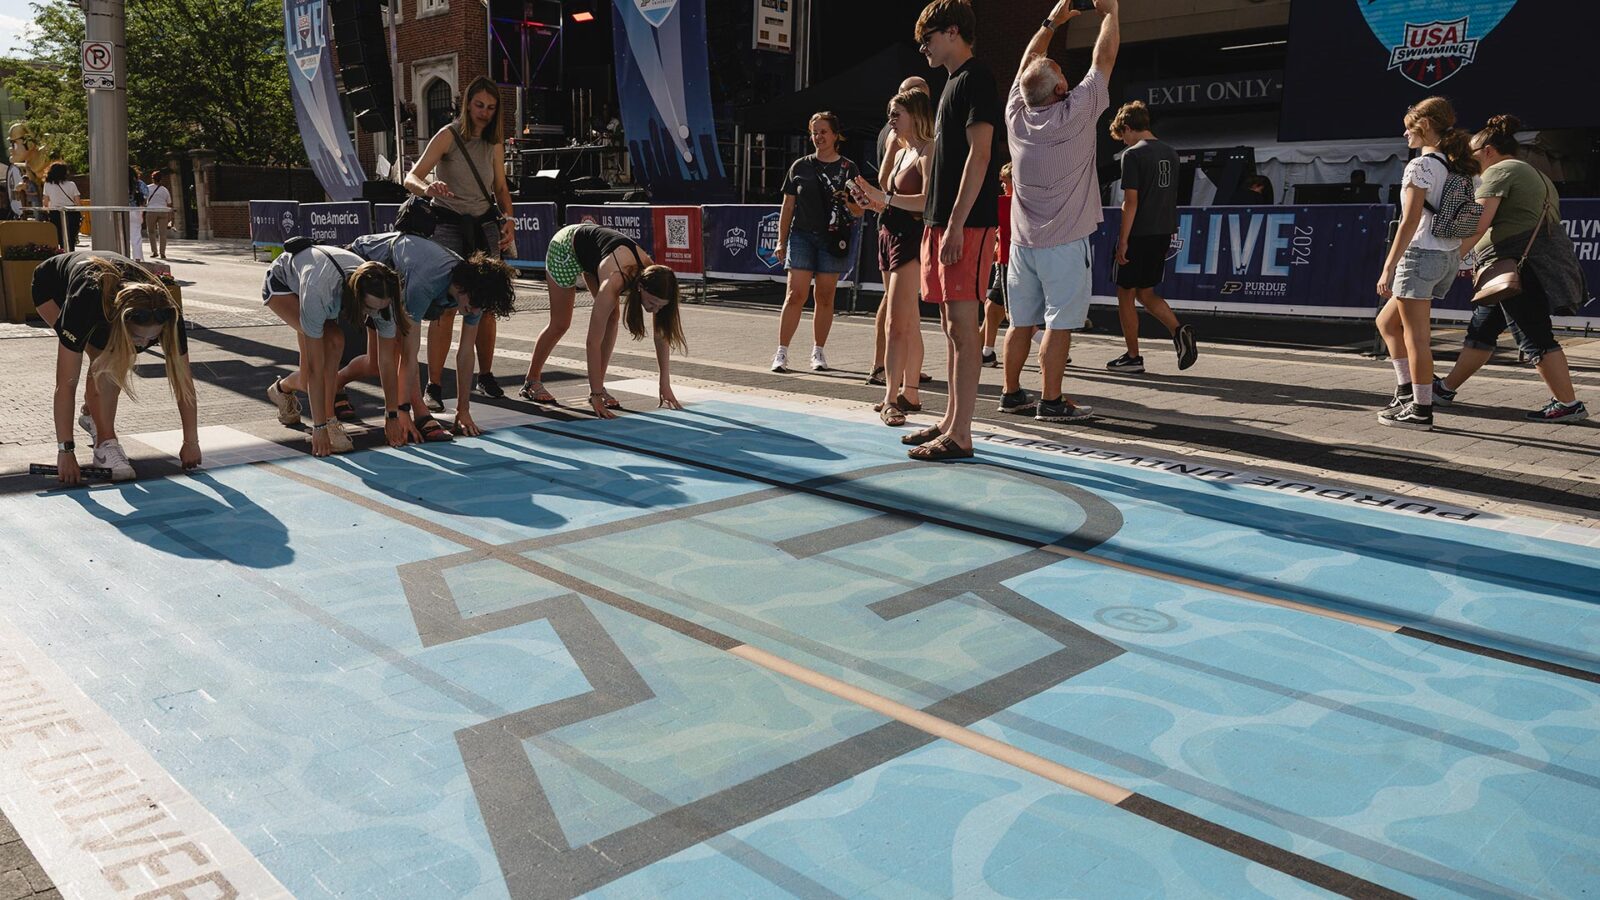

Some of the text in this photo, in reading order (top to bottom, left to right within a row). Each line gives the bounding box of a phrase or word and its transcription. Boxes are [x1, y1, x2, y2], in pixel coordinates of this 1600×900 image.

[286, 1, 326, 55] LIVE
[1410, 26, 1458, 48] USA
[1397, 44, 1468, 60] SWIMMING
[1148, 79, 1272, 105] EXIT ONLY
[1159, 160, 1170, 187] 8
[310, 211, 359, 225] OneAmerica
[514, 213, 540, 230] erica
[602, 216, 640, 227] U.S. OLYMPIC
[311, 228, 337, 239] Financial
[760, 238, 778, 250] IND
[1174, 213, 1296, 277] LIVE
[1290, 225, 1314, 266] 2024
[1573, 241, 1600, 260] TRI
[1245, 281, 1287, 293] PURDUE
[973, 434, 1480, 521] PURDUE UNIVERSITY
